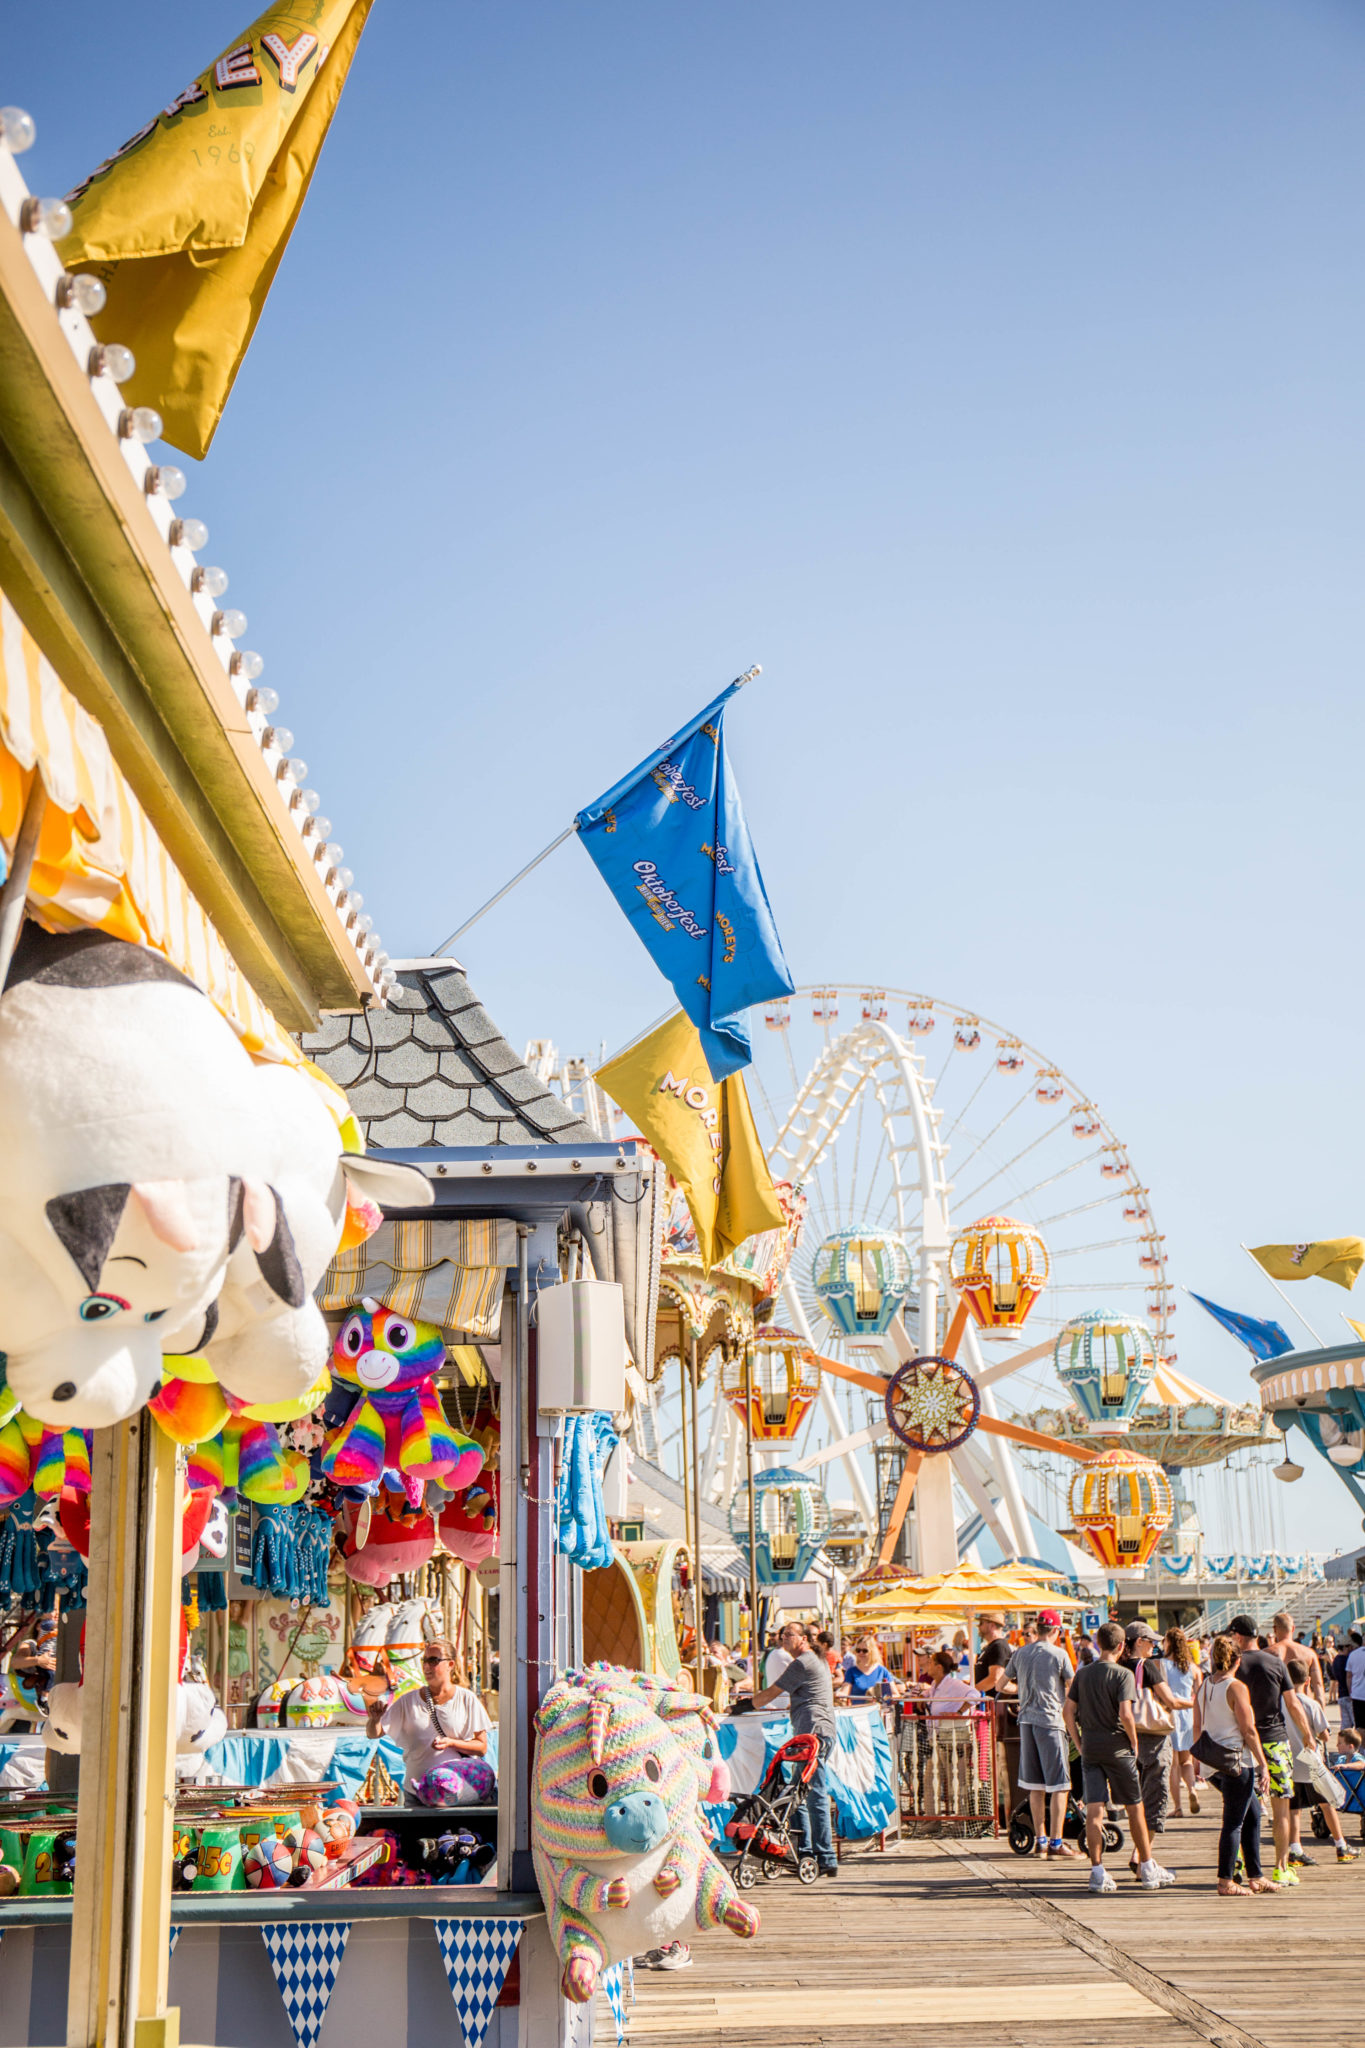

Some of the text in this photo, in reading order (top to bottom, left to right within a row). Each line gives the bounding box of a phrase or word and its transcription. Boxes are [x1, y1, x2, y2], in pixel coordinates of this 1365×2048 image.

[208, 125, 231, 138] Est.
[191, 142, 255, 167] 1969
[632, 859, 708, 940] Oktoberfest
[640, 886, 655, 901] BIER
[659, 914, 673, 929] PIER
[715, 910, 736, 963] MOREY'S
